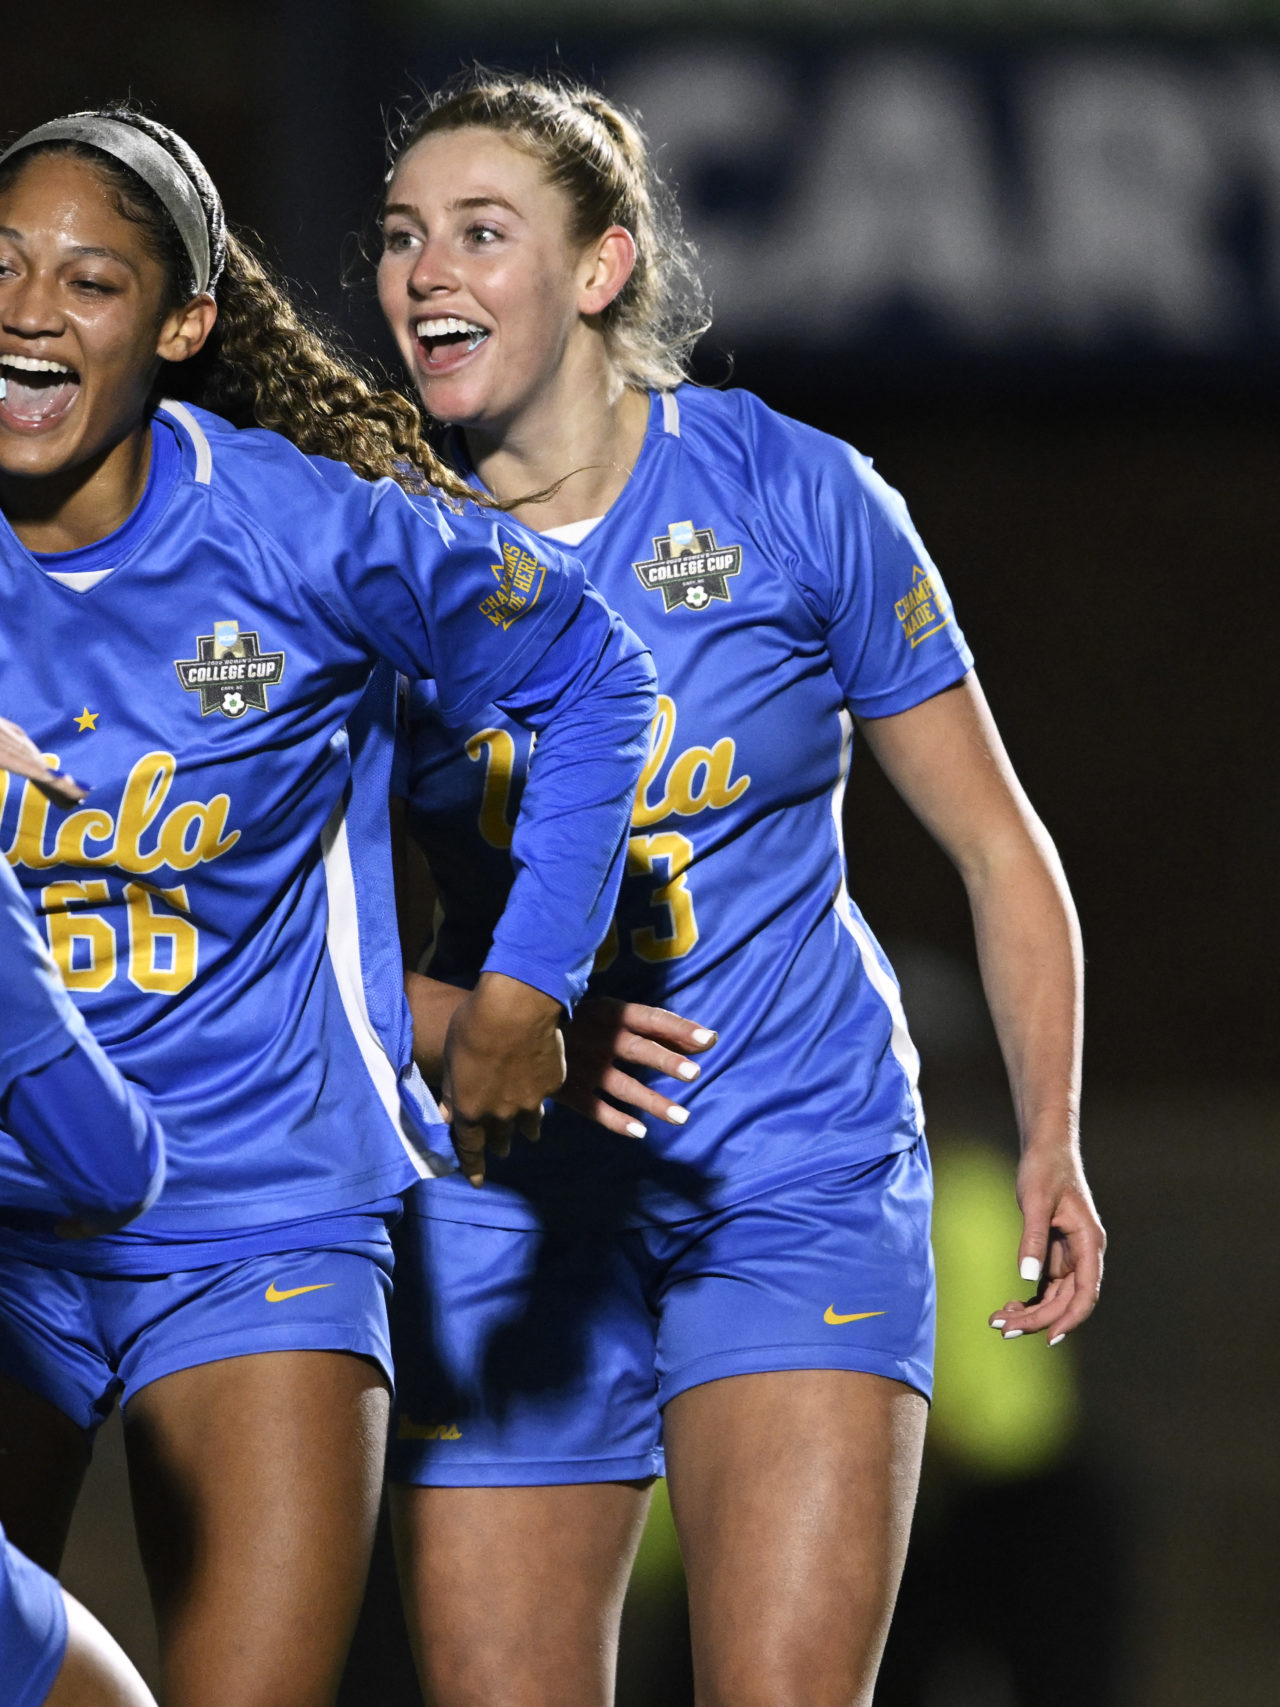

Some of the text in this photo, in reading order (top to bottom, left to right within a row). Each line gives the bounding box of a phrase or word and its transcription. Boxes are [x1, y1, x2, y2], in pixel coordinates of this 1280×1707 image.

[612, 45, 1280, 350] CAR
[487, 551, 539, 627] MADE HERE
[648, 554, 733, 582] COLLEGE CUP
[902, 602, 936, 640] MADE
[188, 662, 275, 683] COLLEGE CUP
[464, 694, 751, 849] Ula
[40, 879, 198, 995] 66
[593, 831, 699, 973] 3
